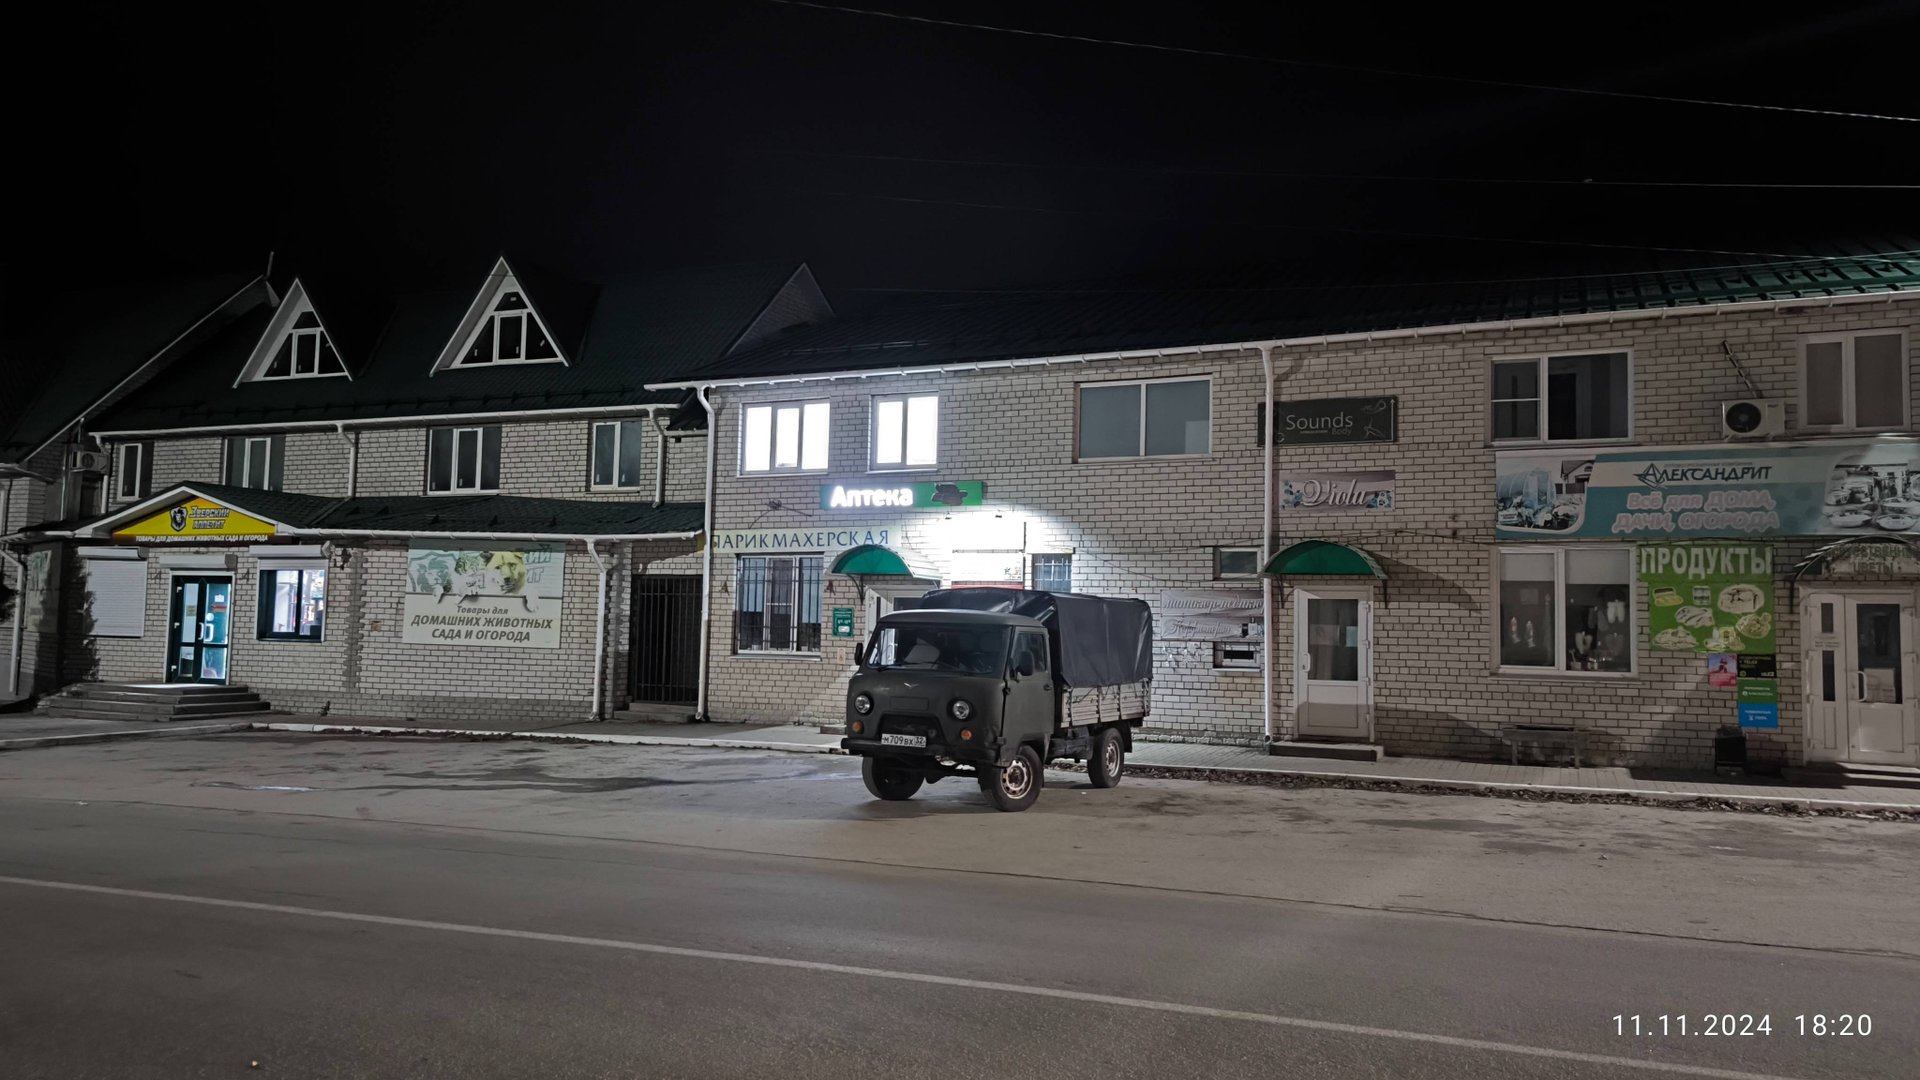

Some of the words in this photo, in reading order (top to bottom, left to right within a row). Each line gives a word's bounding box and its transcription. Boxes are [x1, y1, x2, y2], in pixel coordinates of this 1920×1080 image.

[1286, 412, 1353, 430] Sounds
[830, 485, 913, 508] Аптека
[1303, 479, 1367, 507] Viola
[1627, 491, 1663, 510] Всё
[1663, 494, 1703, 512] для
[1704, 489, 1776, 512] ДОМА,
[1612, 512, 1675, 533] ДАЧИ,
[1678, 511, 1780, 532] ОГОРОДА
[1641, 547, 1773, 580] ПРОДУКТЫ
[457, 605, 489, 615] Товары
[492, 607, 508, 615] для
[411, 614, 480, 627] ДОМАШНИХ
[483, 617, 553, 629] ЖИВОТНЫХ
[432, 628, 461, 641] САДА
[464, 630, 473, 639] И
[476, 630, 531, 643] ОГОРОДА
